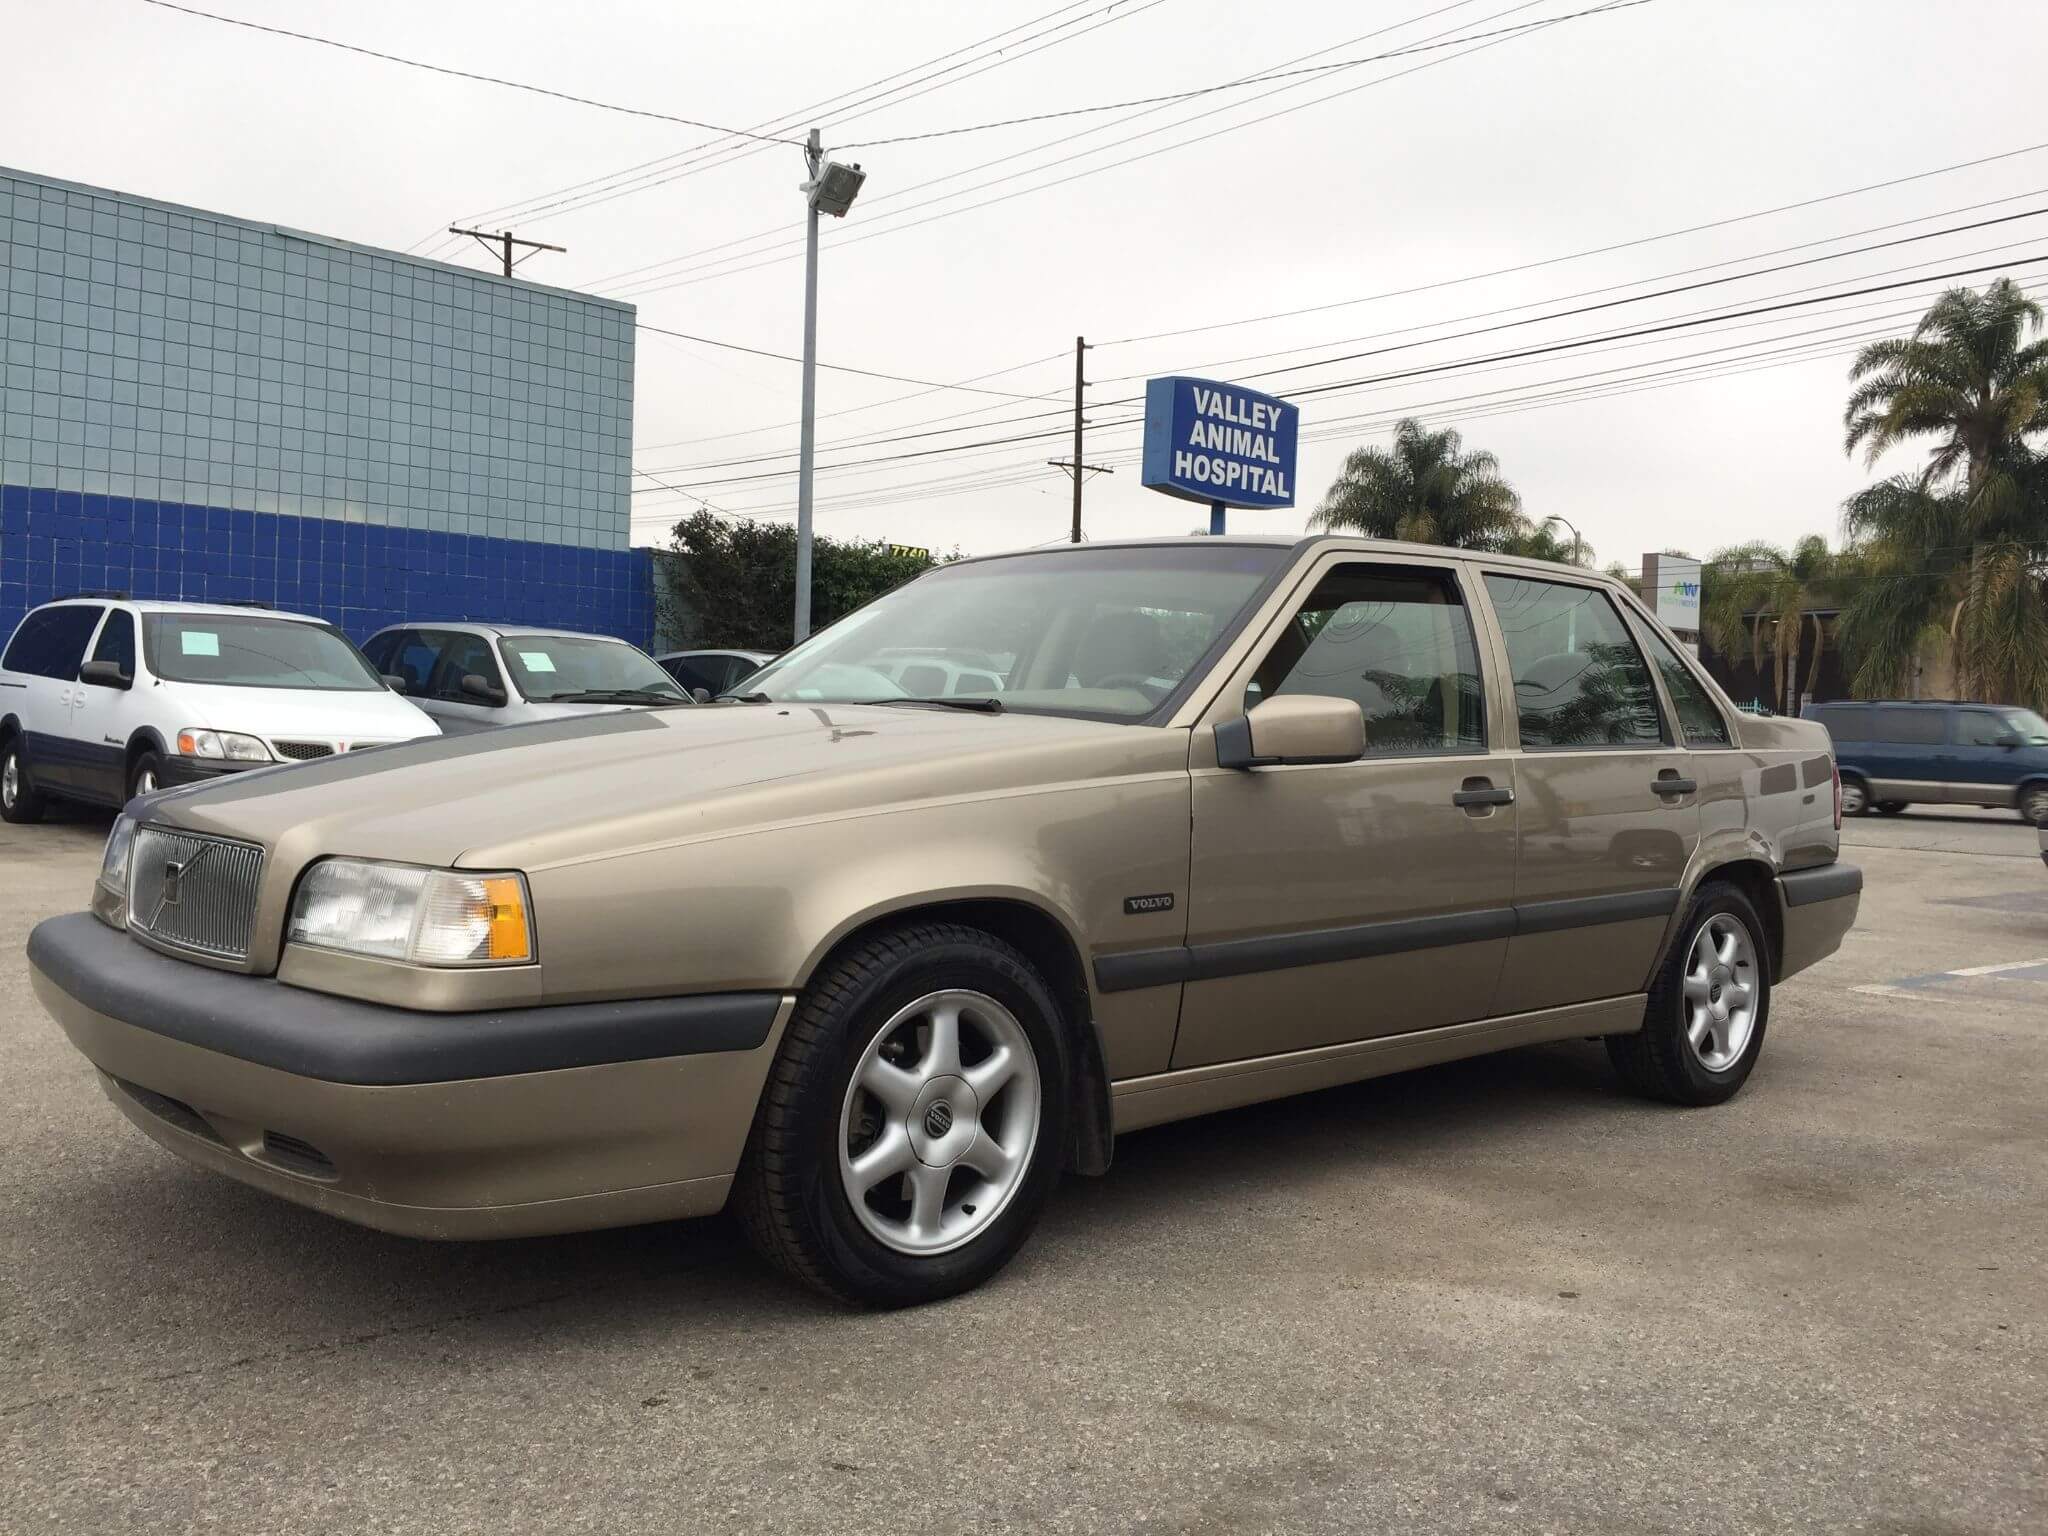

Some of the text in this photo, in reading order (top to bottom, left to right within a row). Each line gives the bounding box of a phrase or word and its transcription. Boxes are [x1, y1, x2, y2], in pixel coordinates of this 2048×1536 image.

[1193, 387, 1282, 432] VALLEY
[1189, 420, 1280, 464] ANIMAL
[1175, 450, 1290, 498] HOSPITAL
[1129, 897, 1172, 910] VOLVO
